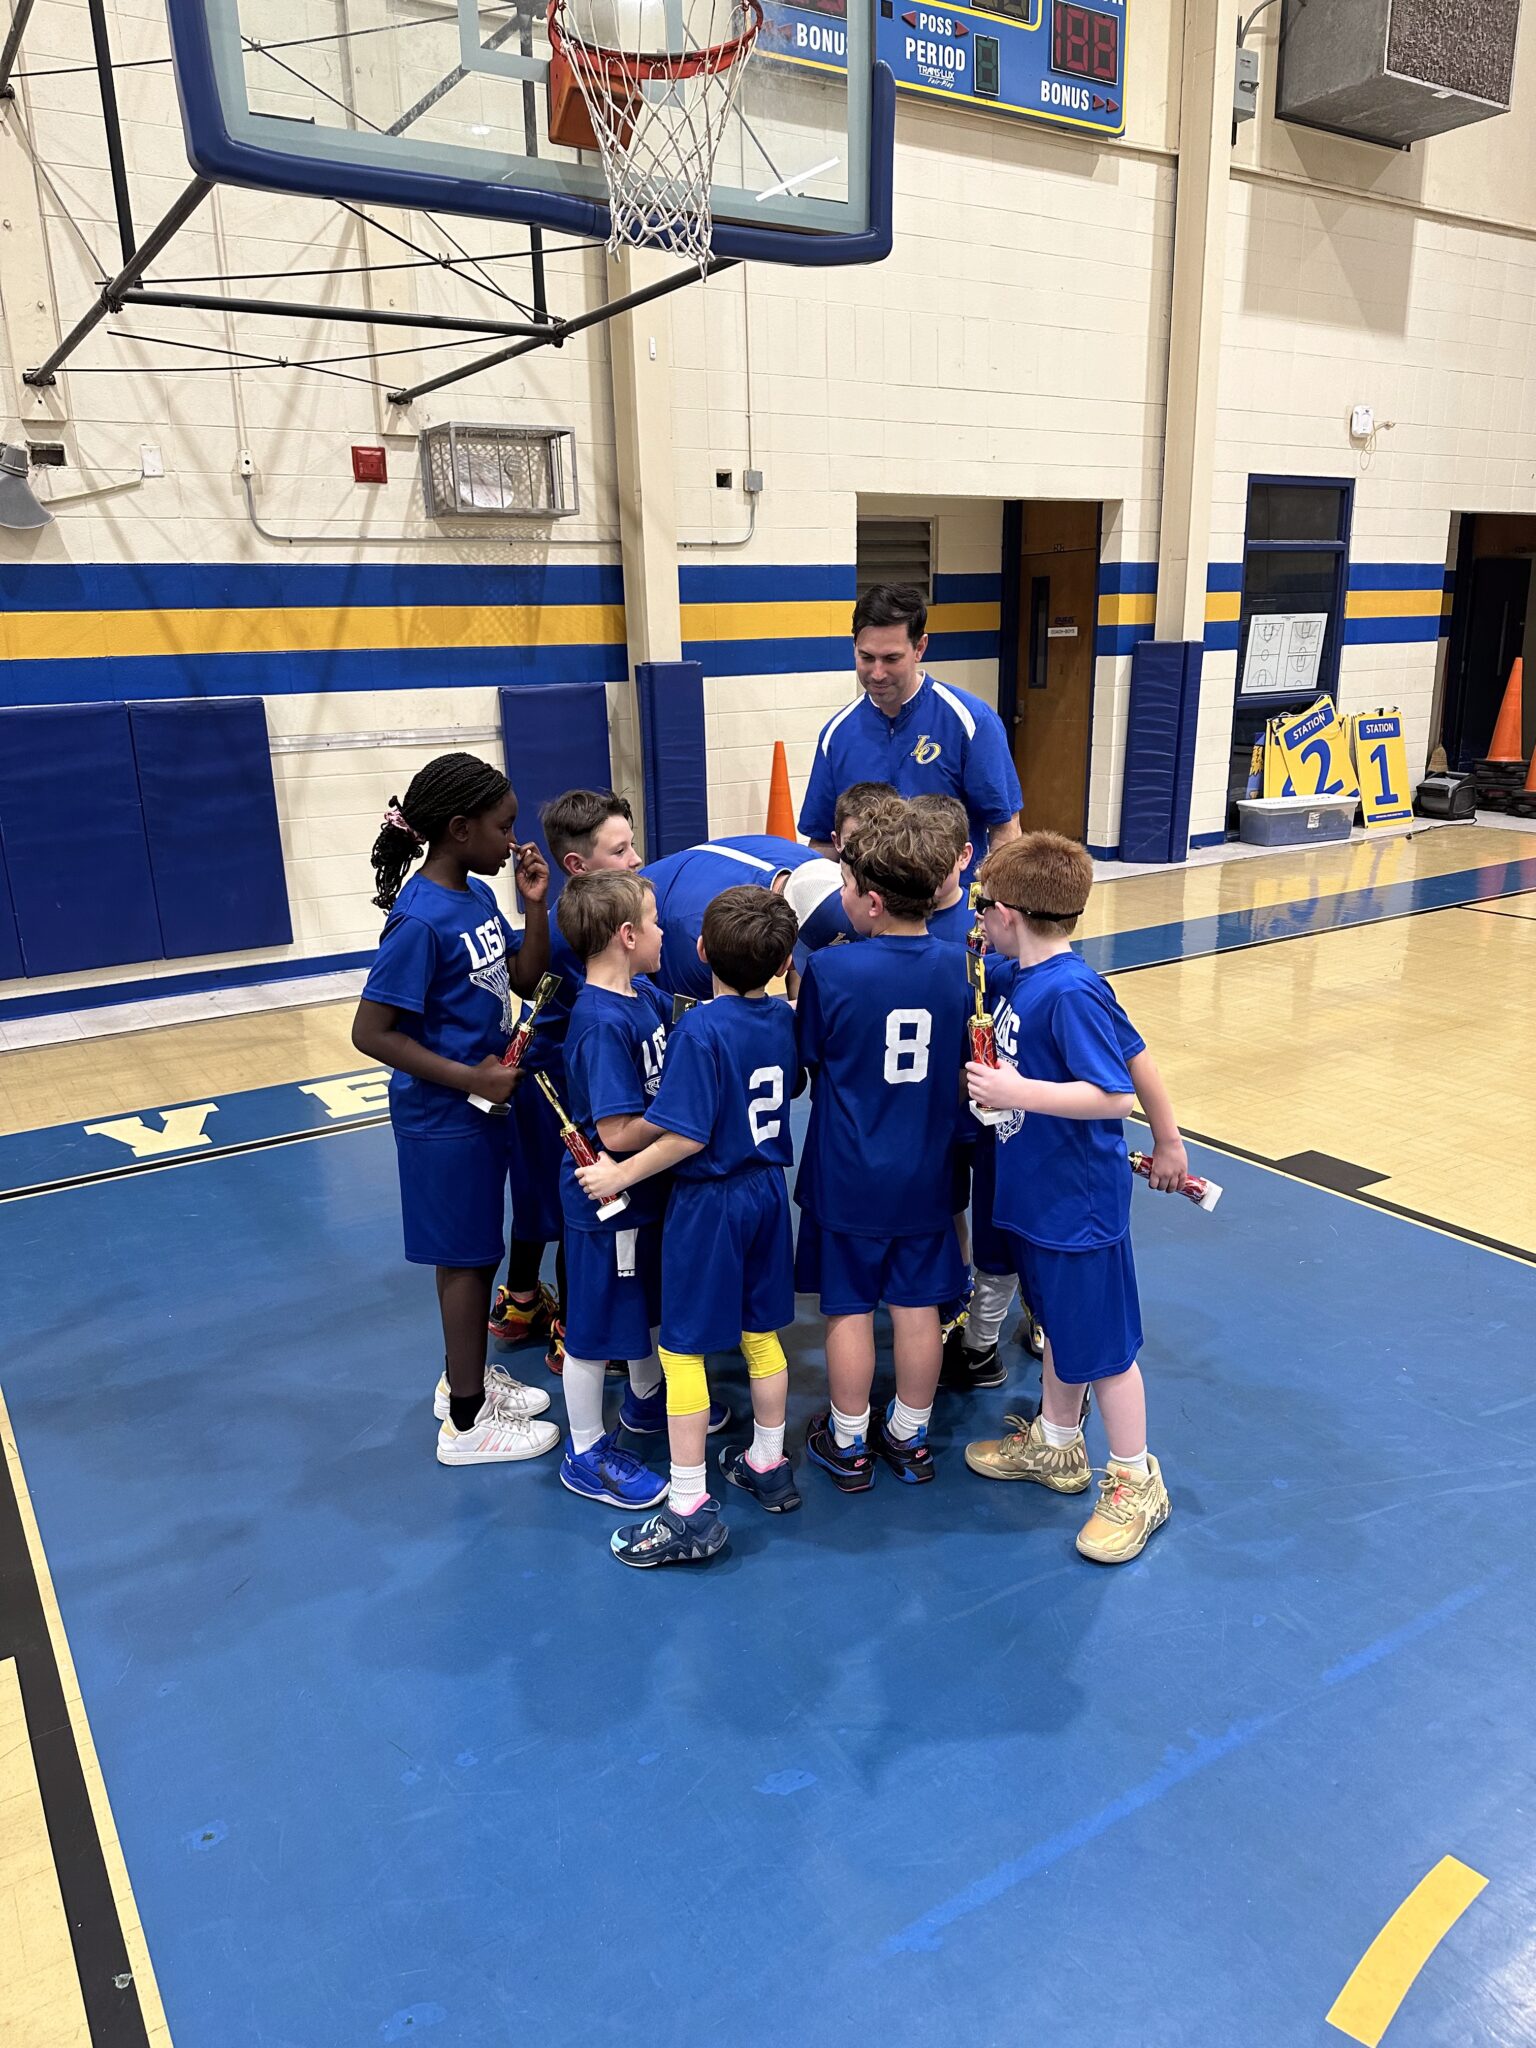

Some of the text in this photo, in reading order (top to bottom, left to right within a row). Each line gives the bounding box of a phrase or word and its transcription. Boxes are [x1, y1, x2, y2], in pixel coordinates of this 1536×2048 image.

[796, 22, 847, 56] BONU
[919, 12, 952, 36] POSS
[905, 36, 966, 71] PERIOD
[1041, 79, 1090, 111] BONUS
[1292, 711, 1326, 741] STATION
[1365, 722, 1394, 734] STATION
[1301, 738, 1345, 795] 2
[1370, 743, 1399, 806] 1
[884, 1008, 932, 1085] 8
[748, 1065, 784, 1147] 2
